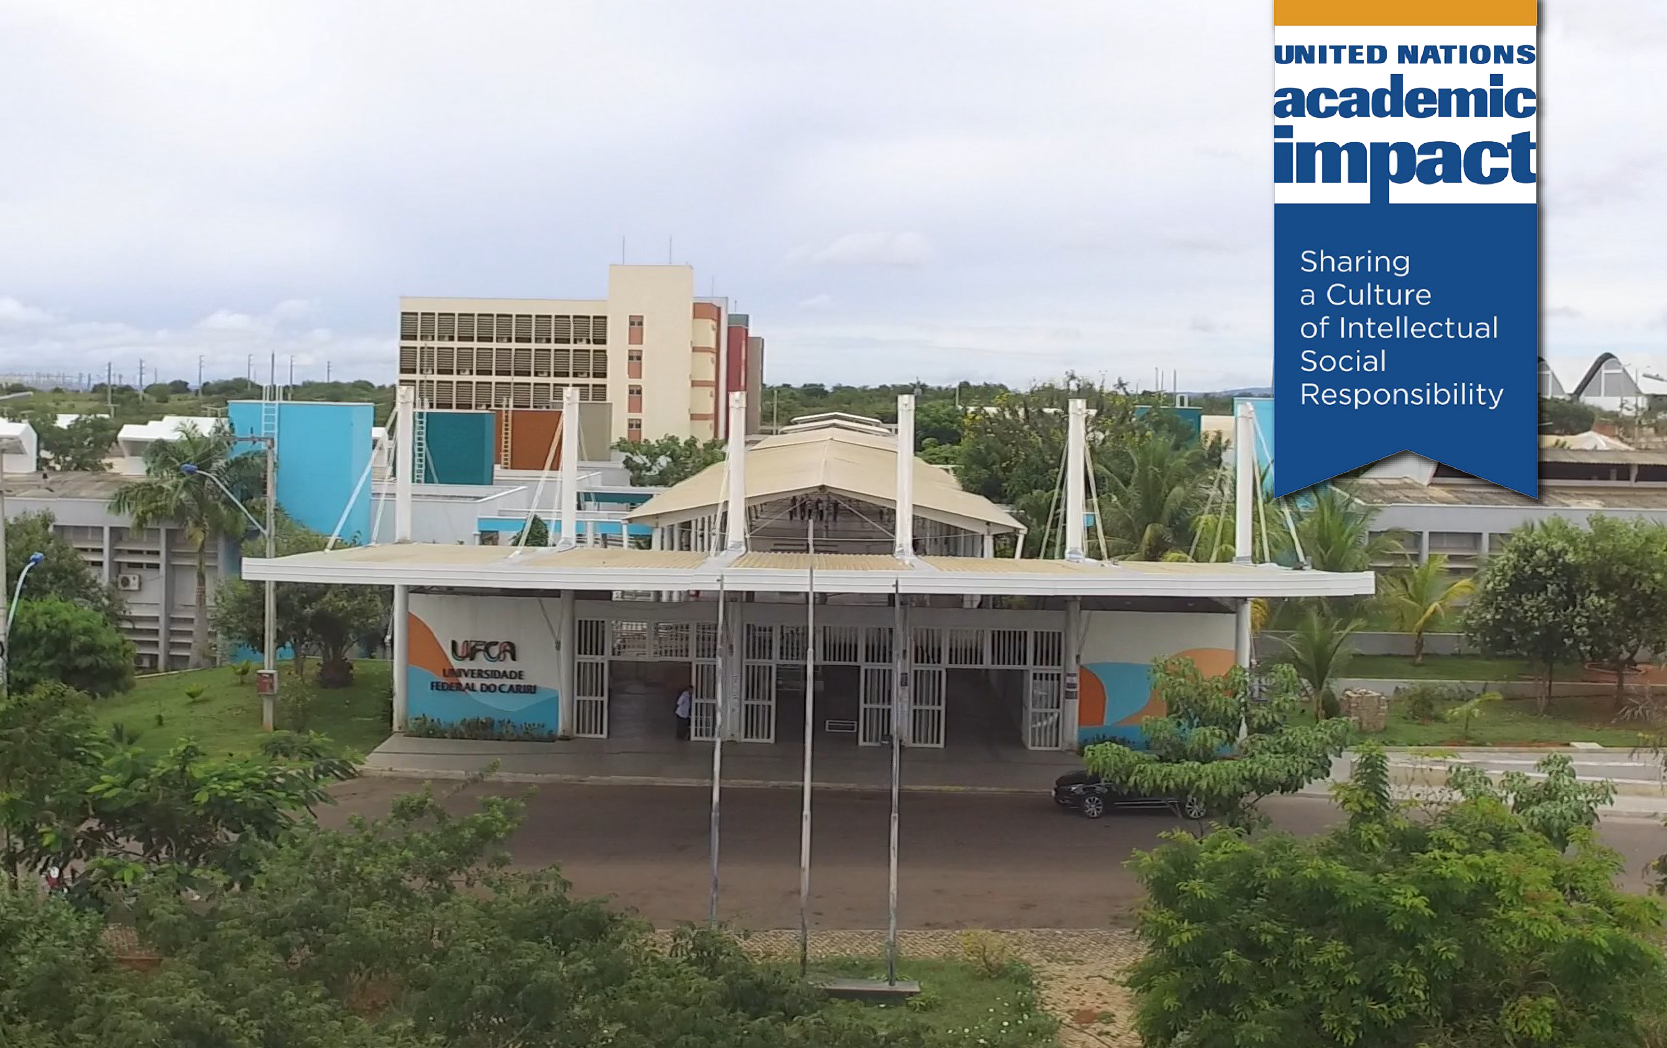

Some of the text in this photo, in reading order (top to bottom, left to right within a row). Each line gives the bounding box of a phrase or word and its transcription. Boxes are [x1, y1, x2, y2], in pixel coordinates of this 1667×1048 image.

[451, 639, 517, 662] UFCA
[442, 668, 525, 680] UNIVERSIDADE
[430, 681, 537, 694] FEDERAL DO CARIRI
